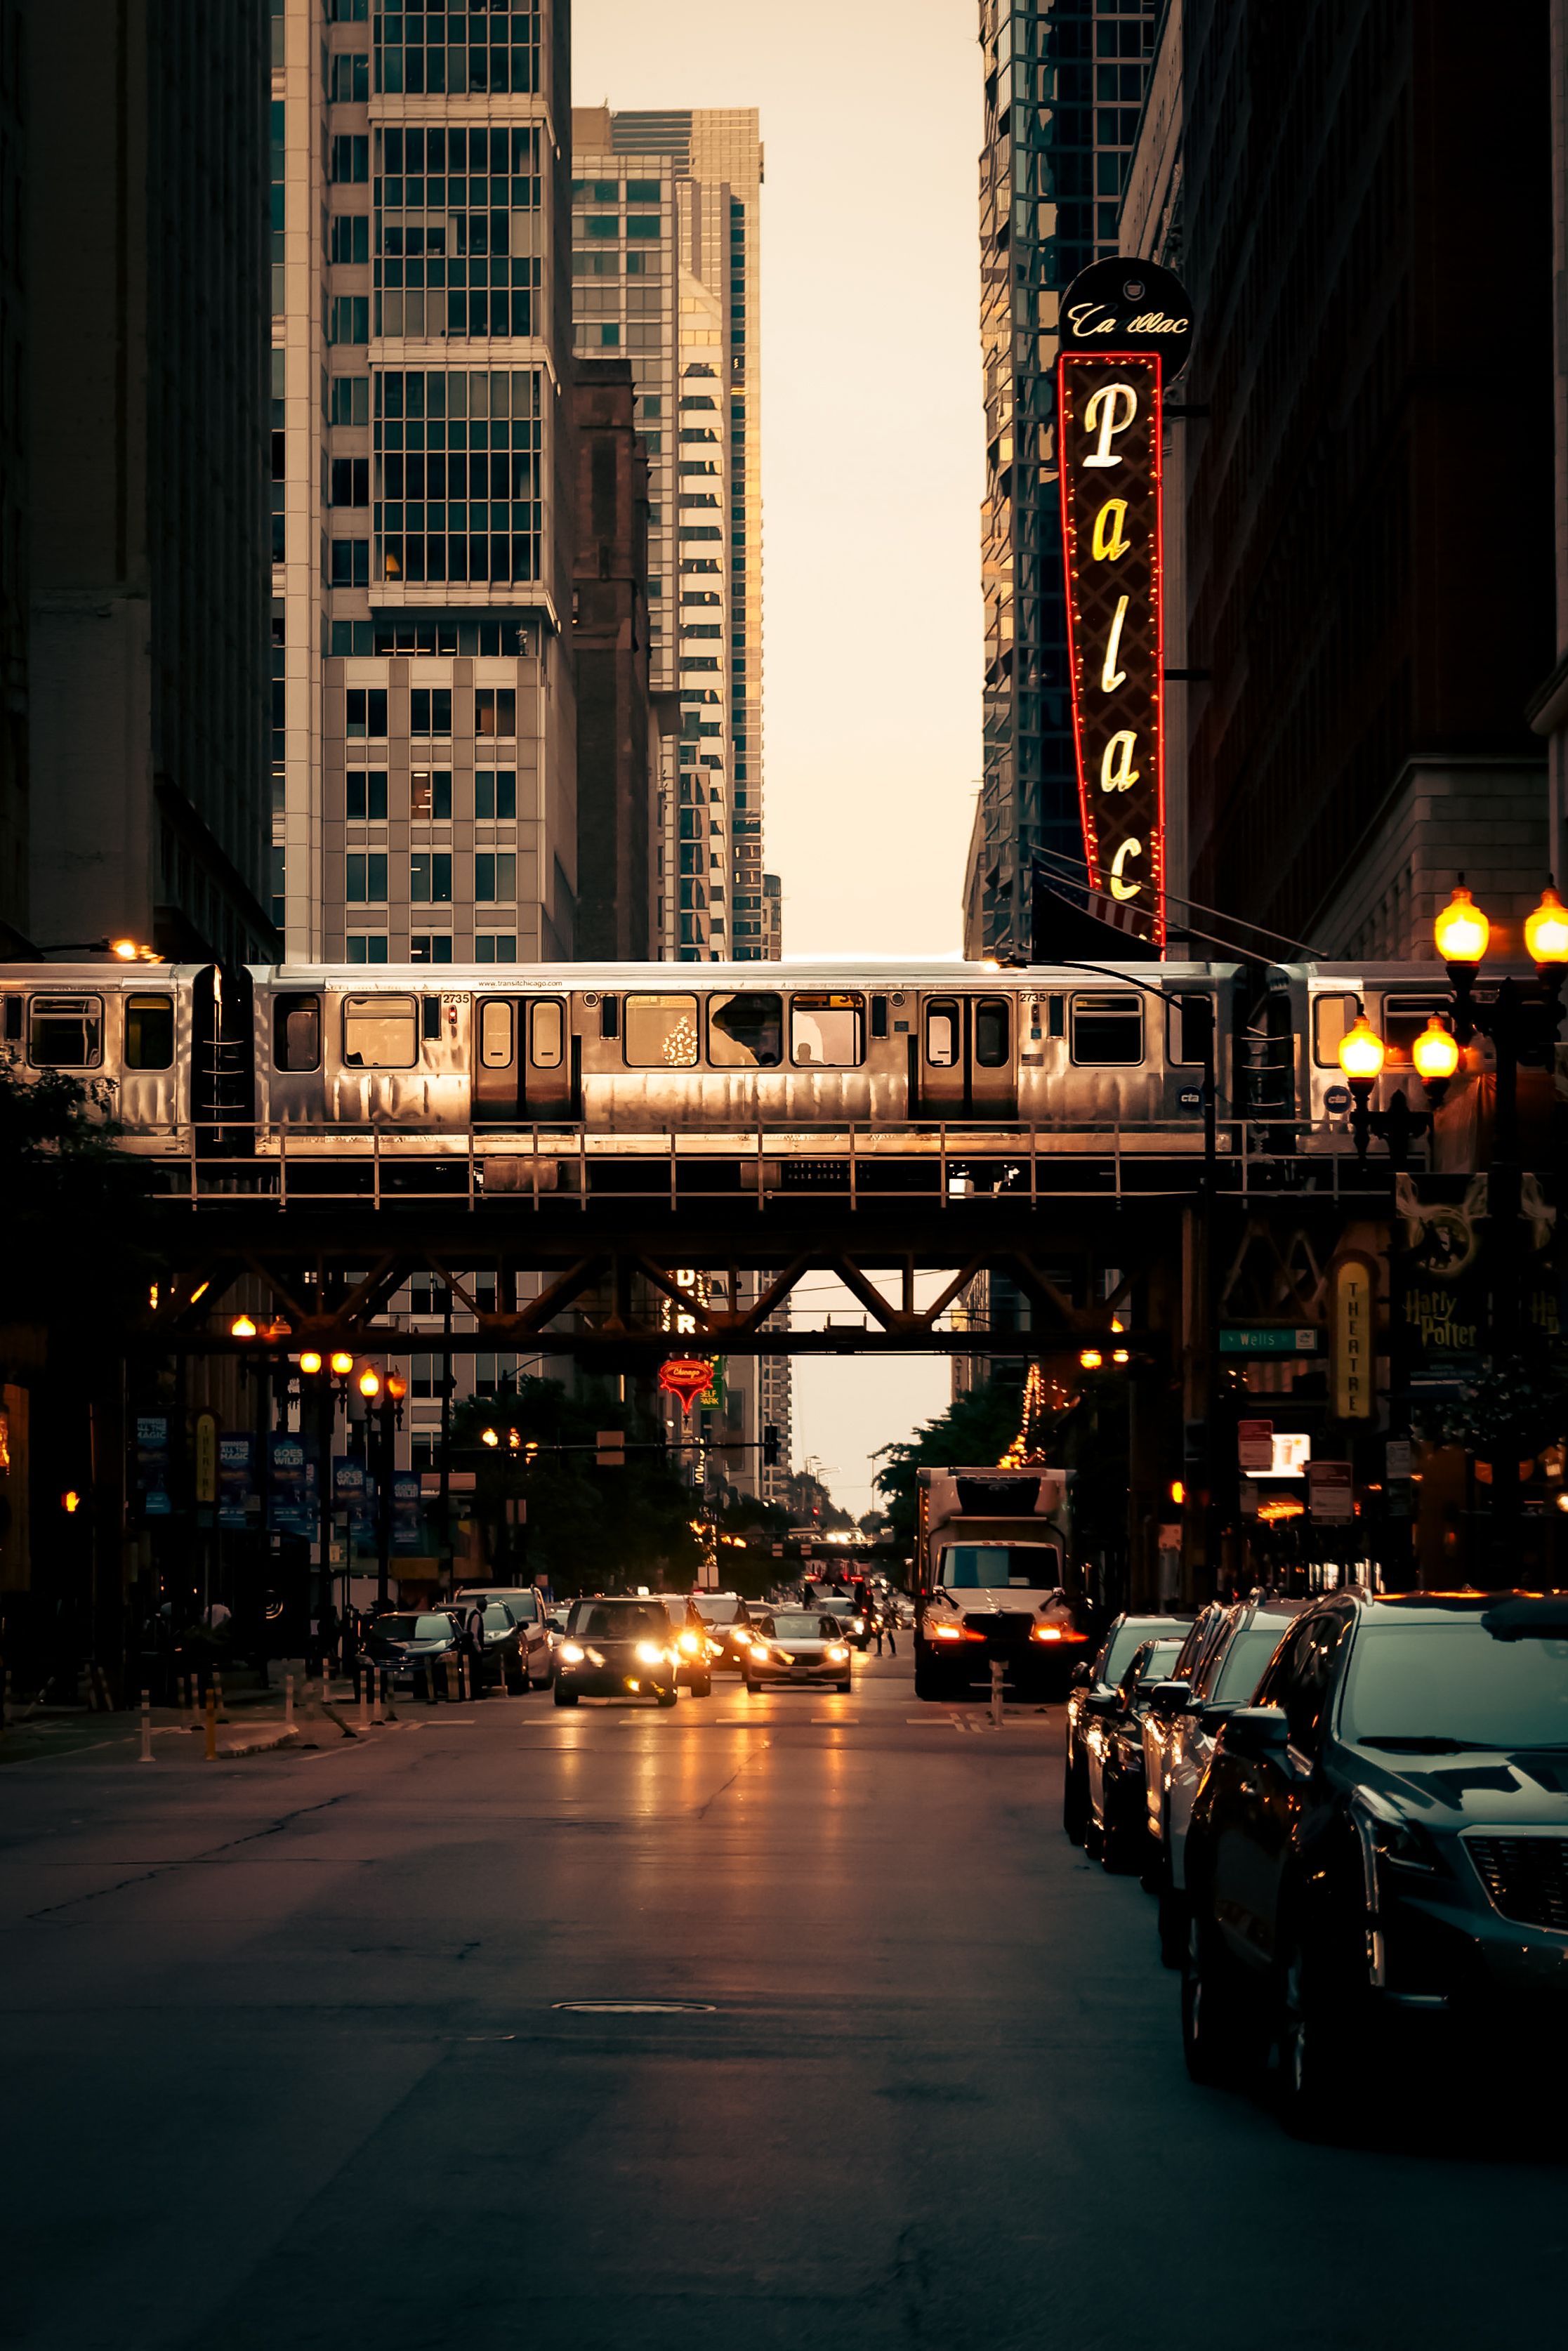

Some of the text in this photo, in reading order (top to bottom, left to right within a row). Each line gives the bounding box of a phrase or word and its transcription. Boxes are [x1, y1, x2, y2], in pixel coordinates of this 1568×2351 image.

[1082, 383, 1142, 901] Palac
[443, 994, 469, 1003] 2735
[1020, 993, 1046, 1002] 2735
[1399, 1288, 1458, 1326] Harry
[1421, 1315, 1477, 1348] Potter
[1240, 1333, 1275, 1346] Wells
[1348, 1282, 1359, 1411] THEATRE
[273, 1449, 303, 1457] GOES
[273, 1457, 304, 1466] WILD!
